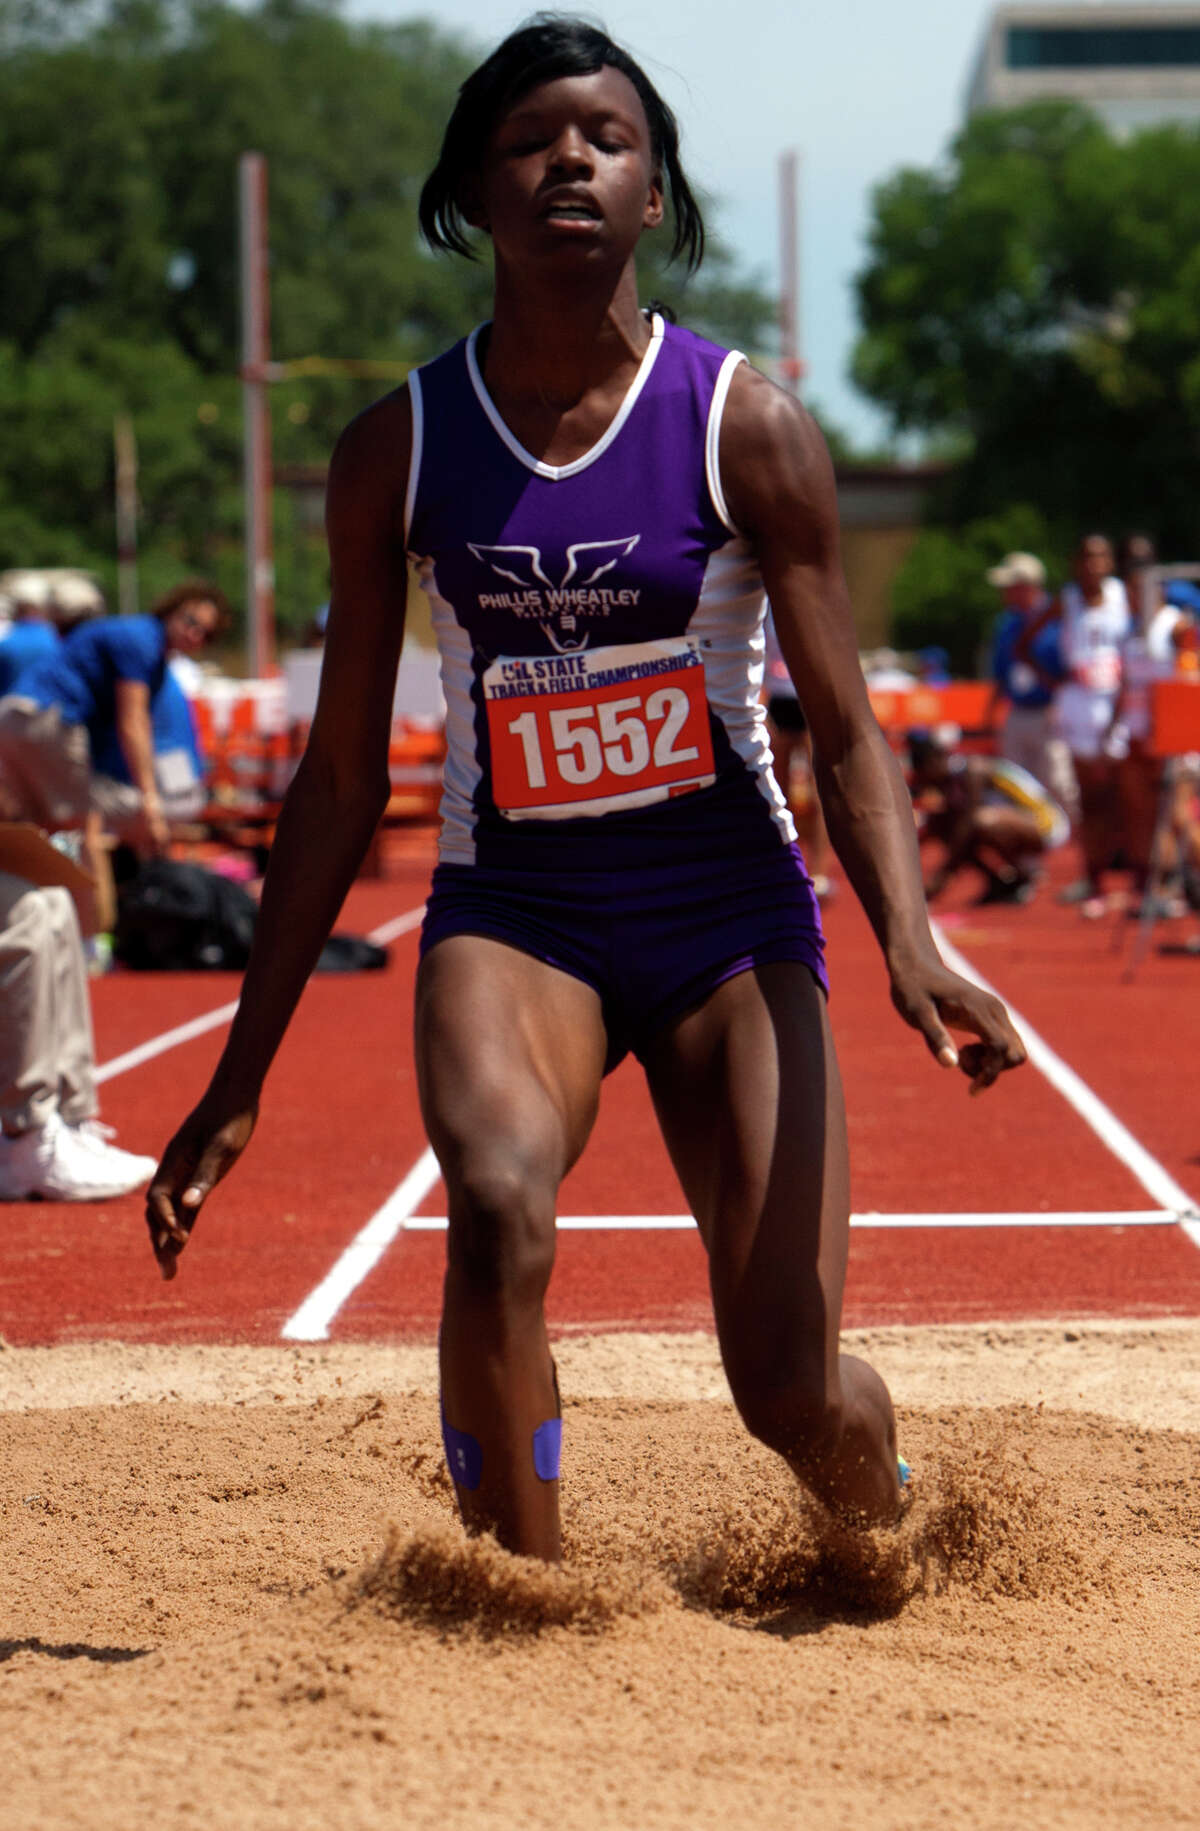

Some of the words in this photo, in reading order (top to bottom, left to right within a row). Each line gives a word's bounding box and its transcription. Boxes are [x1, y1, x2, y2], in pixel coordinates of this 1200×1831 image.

[478, 590, 541, 609] PHILLIS
[545, 589, 640, 606] WHEATLEY
[489, 680, 537, 699] TRACK
[537, 681, 549, 695] &
[549, 675, 585, 694] FIELD
[587, 652, 699, 689] CHAMPIONSHIPS
[534, 656, 587, 679] STATE
[508, 687, 699, 789] 1552
